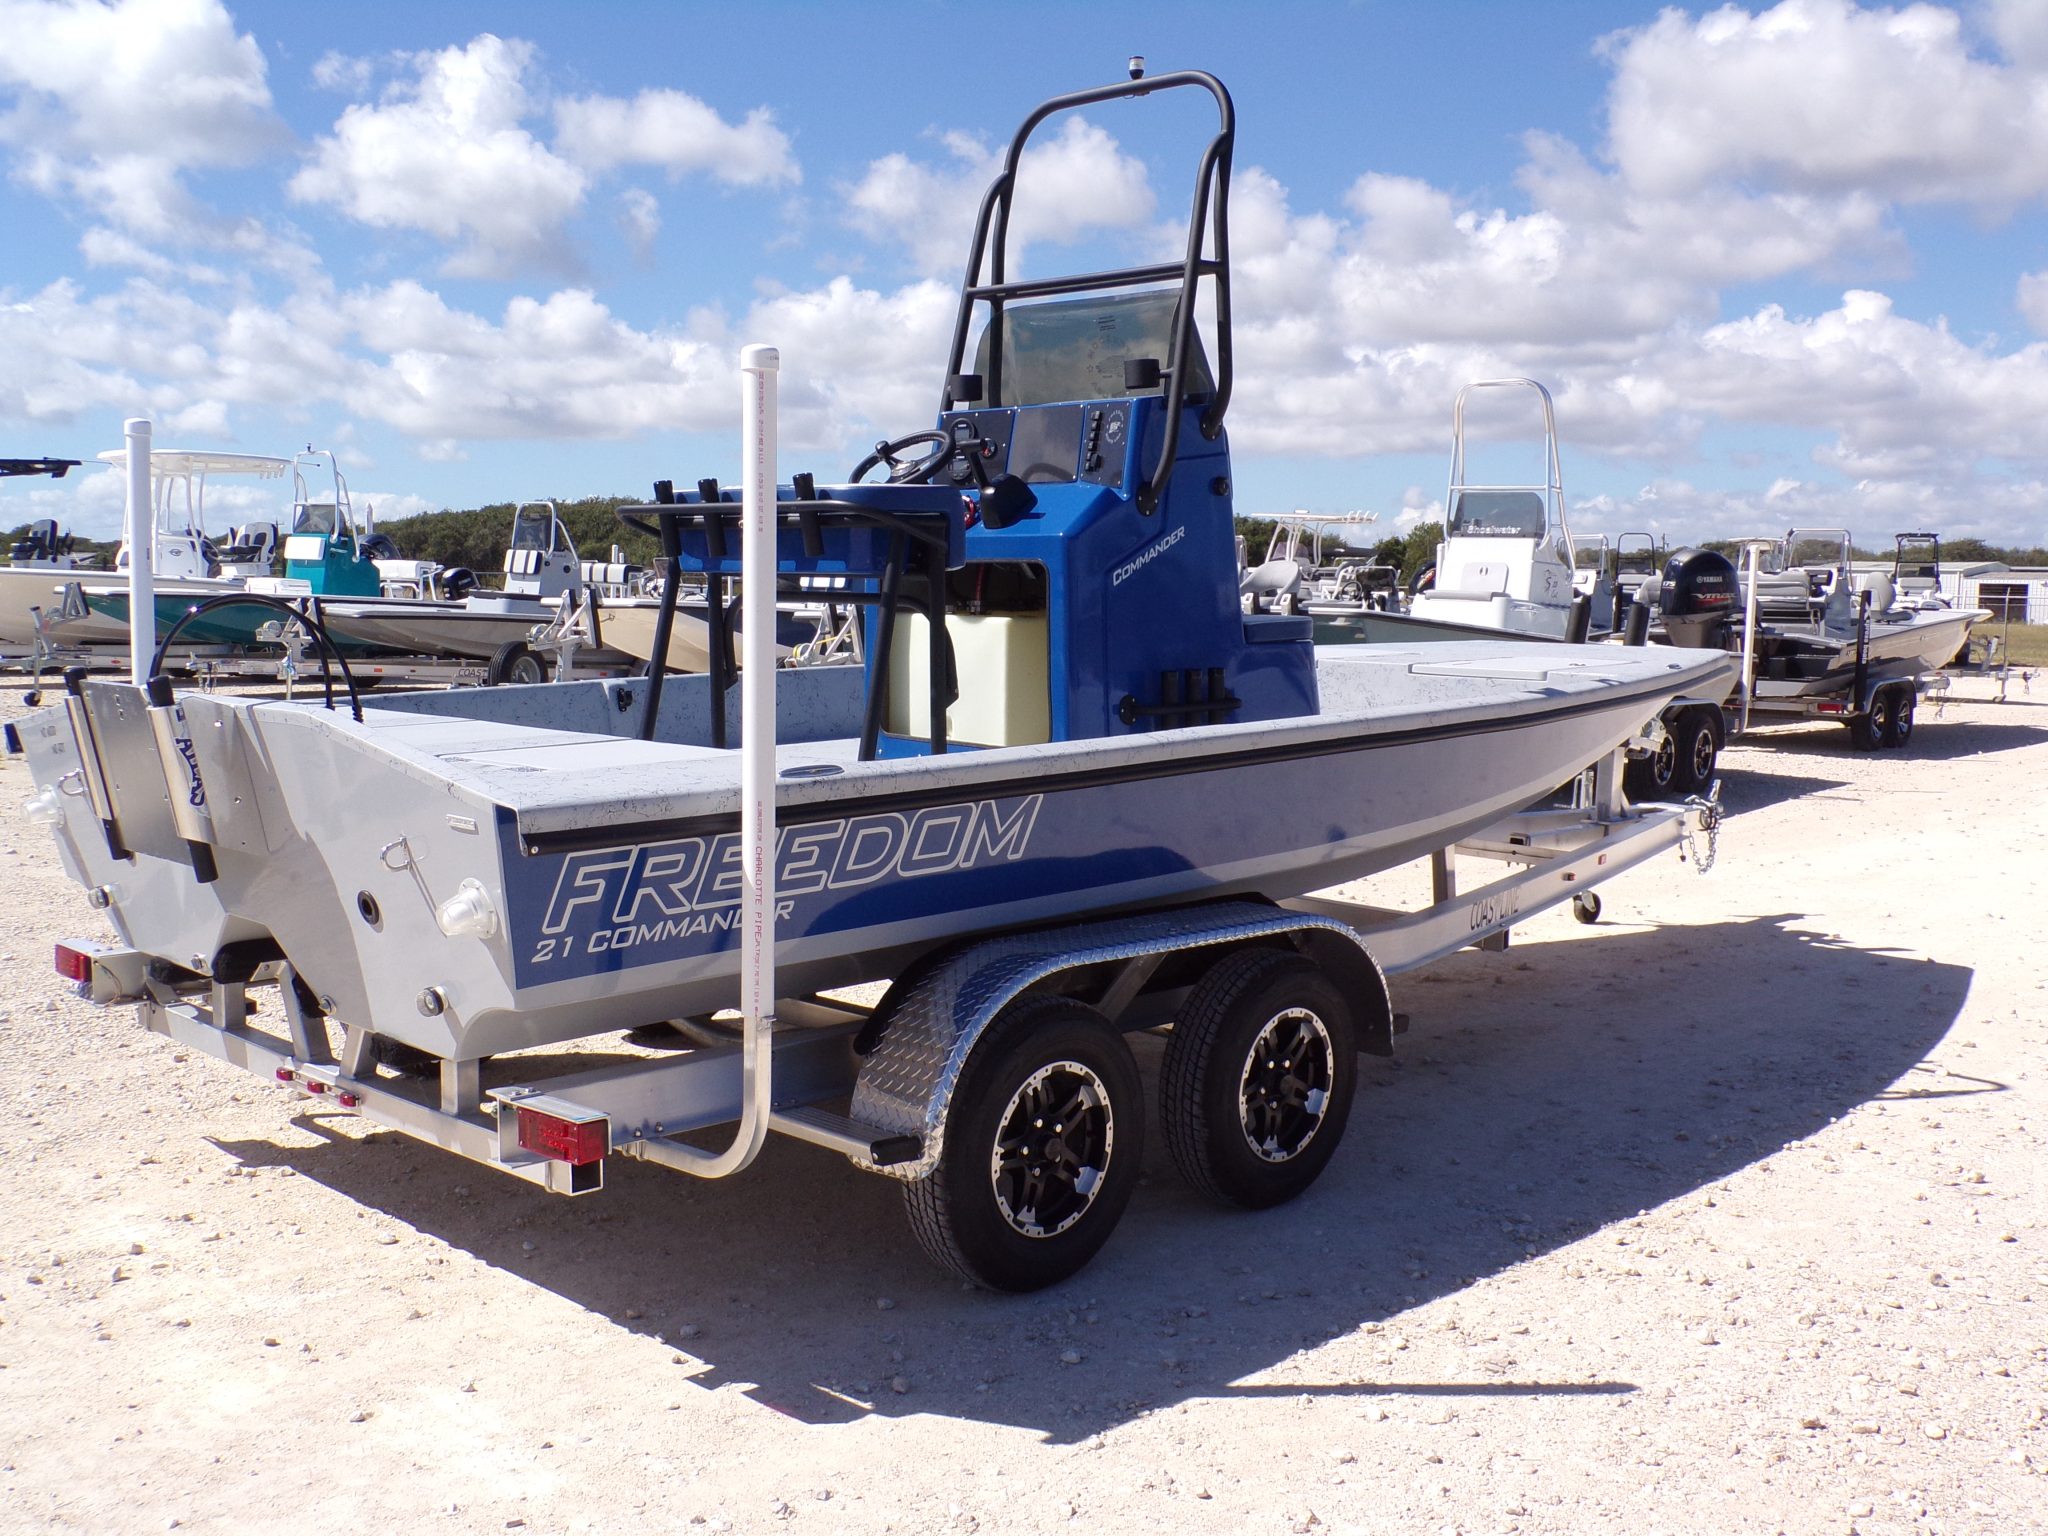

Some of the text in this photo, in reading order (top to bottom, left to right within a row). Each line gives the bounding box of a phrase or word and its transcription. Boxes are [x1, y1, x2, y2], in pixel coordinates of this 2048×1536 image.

[1113, 526, 1185, 586] COMMANDER
[542, 793, 1044, 935] FREEDOM
[755, 846, 763, 905] CHARLOTTE
[531, 900, 795, 963] 21 COMMANR
[754, 911, 762, 938] PIPE
